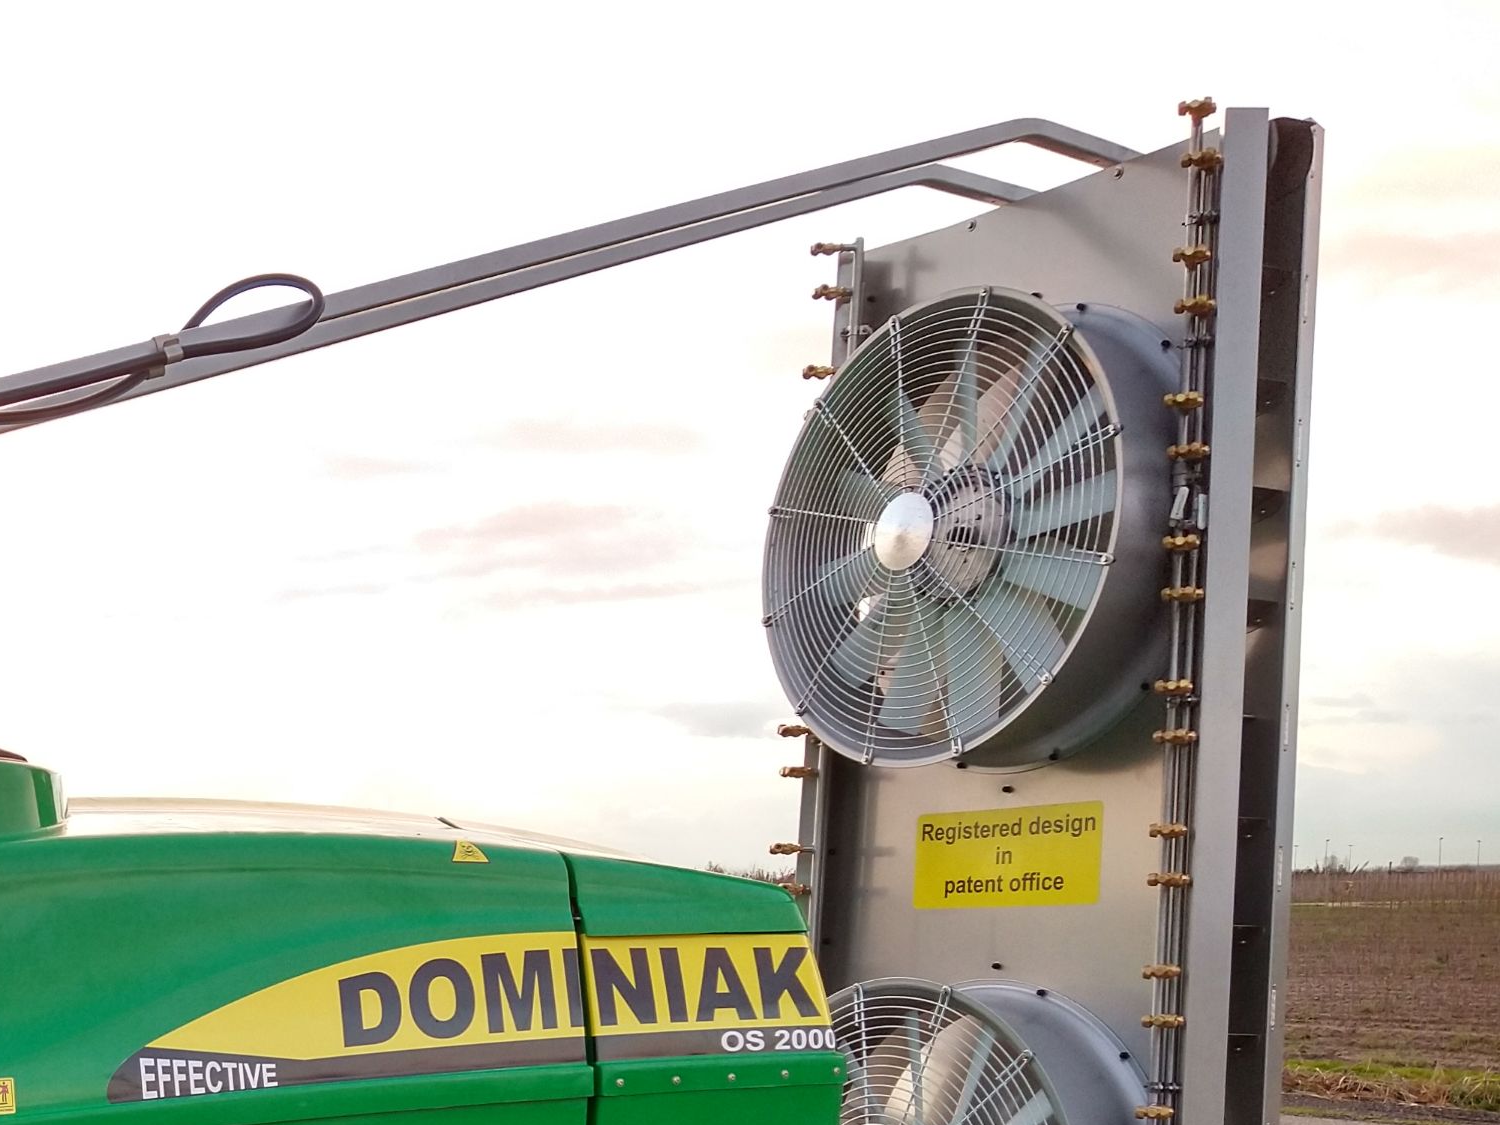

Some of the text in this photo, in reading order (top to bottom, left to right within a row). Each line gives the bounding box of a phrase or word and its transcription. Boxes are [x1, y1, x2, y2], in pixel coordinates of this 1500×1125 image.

[921, 814, 1096, 845] Registered design
[996, 847, 1012, 865] in
[944, 872, 1064, 898] patent office
[338, 946, 821, 1048] DOMINIAK
[721, 1029, 836, 1052] OS 2000
[138, 1056, 278, 1100] EFFECTIVE
